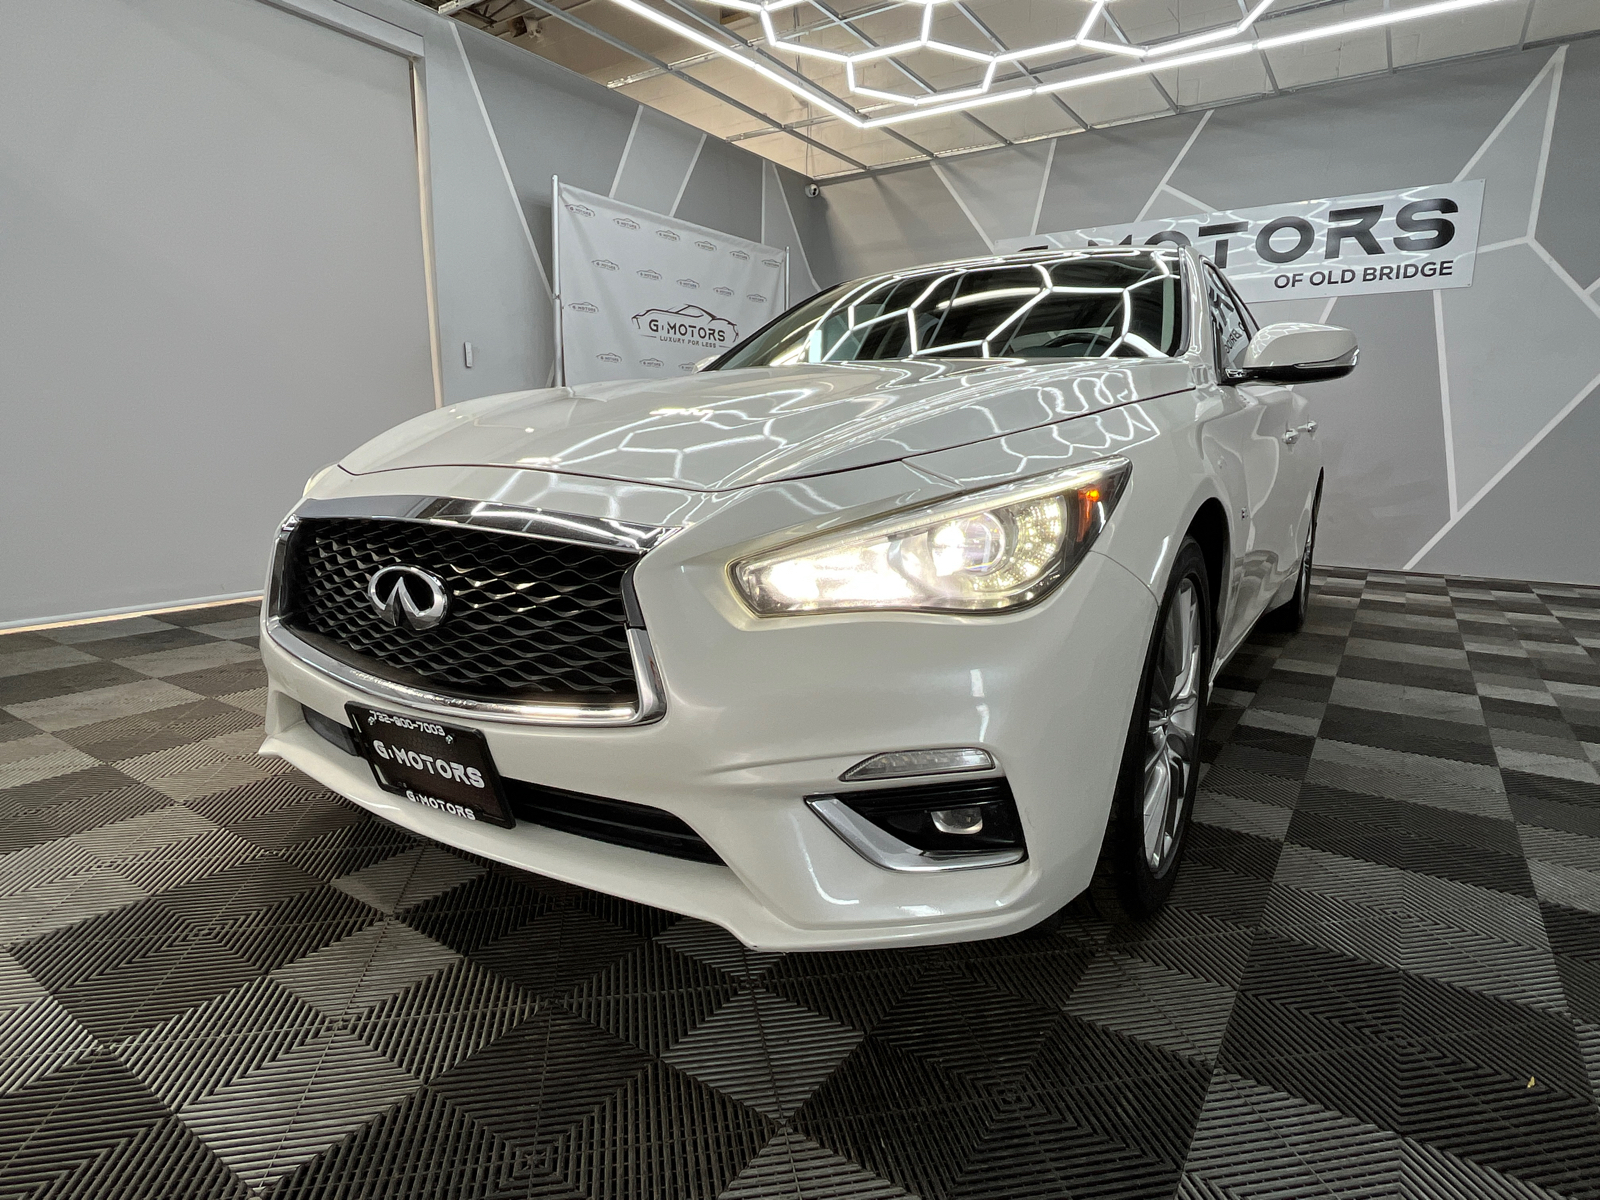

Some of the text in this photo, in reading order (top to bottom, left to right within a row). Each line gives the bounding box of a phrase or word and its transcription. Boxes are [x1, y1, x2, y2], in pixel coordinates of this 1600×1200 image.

[1089, 198, 1459, 269] TORS
[1274, 260, 1454, 289] OF OLD BRIDGE
[659, 335, 685, 344] LUXURY
[667, 321, 726, 342] MOTORS
[392, 744, 486, 789] MOTORS
[418, 795, 476, 821] MOTORS
